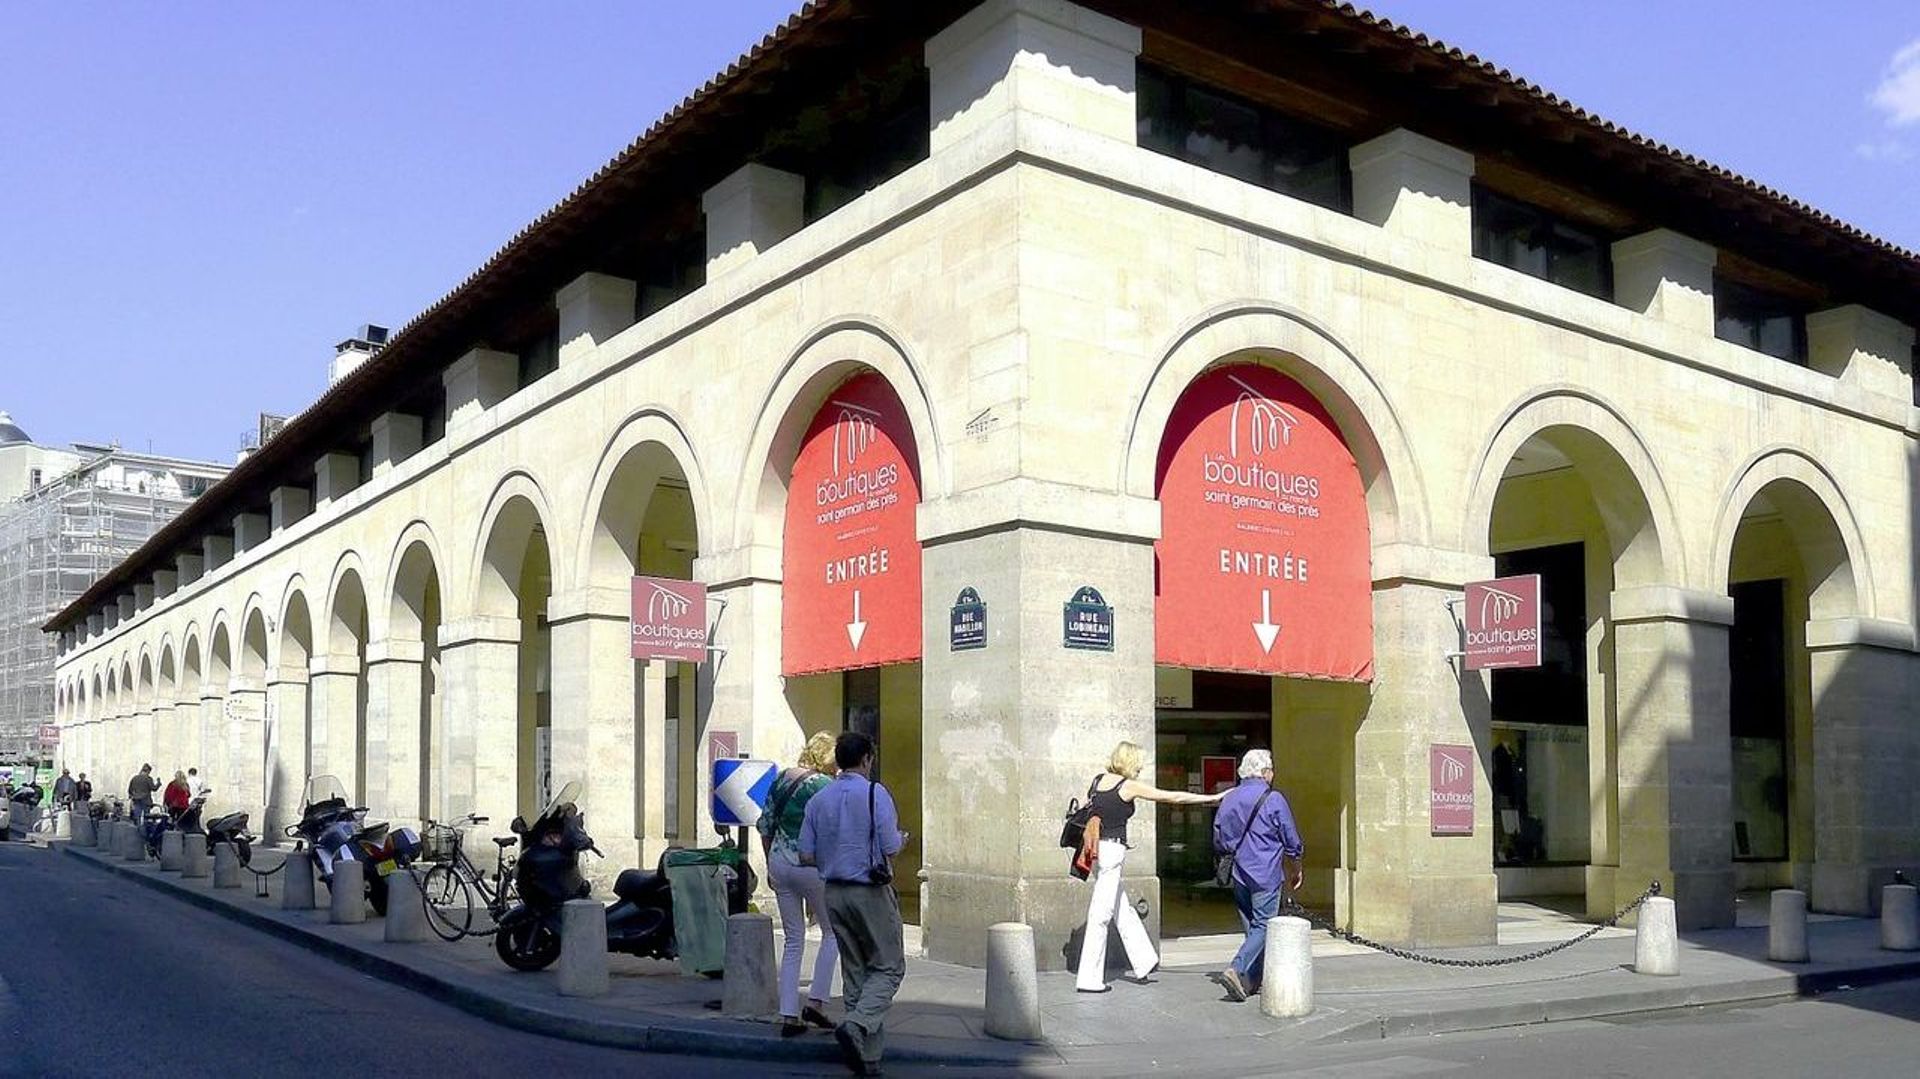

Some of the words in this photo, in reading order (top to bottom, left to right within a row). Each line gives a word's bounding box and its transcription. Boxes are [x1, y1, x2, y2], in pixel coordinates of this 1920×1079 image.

[816, 464, 897, 506] boutiques
[1204, 454, 1319, 498] boutiques
[1205, 490, 1230, 503] saint
[1232, 494, 1276, 509] germain
[1278, 500, 1296, 513] des
[826, 546, 889, 584] ENTRÉE
[1220, 549, 1308, 583] ENTRÉE
[1080, 612, 1098, 622] RUE
[633, 622, 705, 641] boutiques
[1467, 627, 1537, 646] boutiques
[1505, 644, 1536, 655] germain
